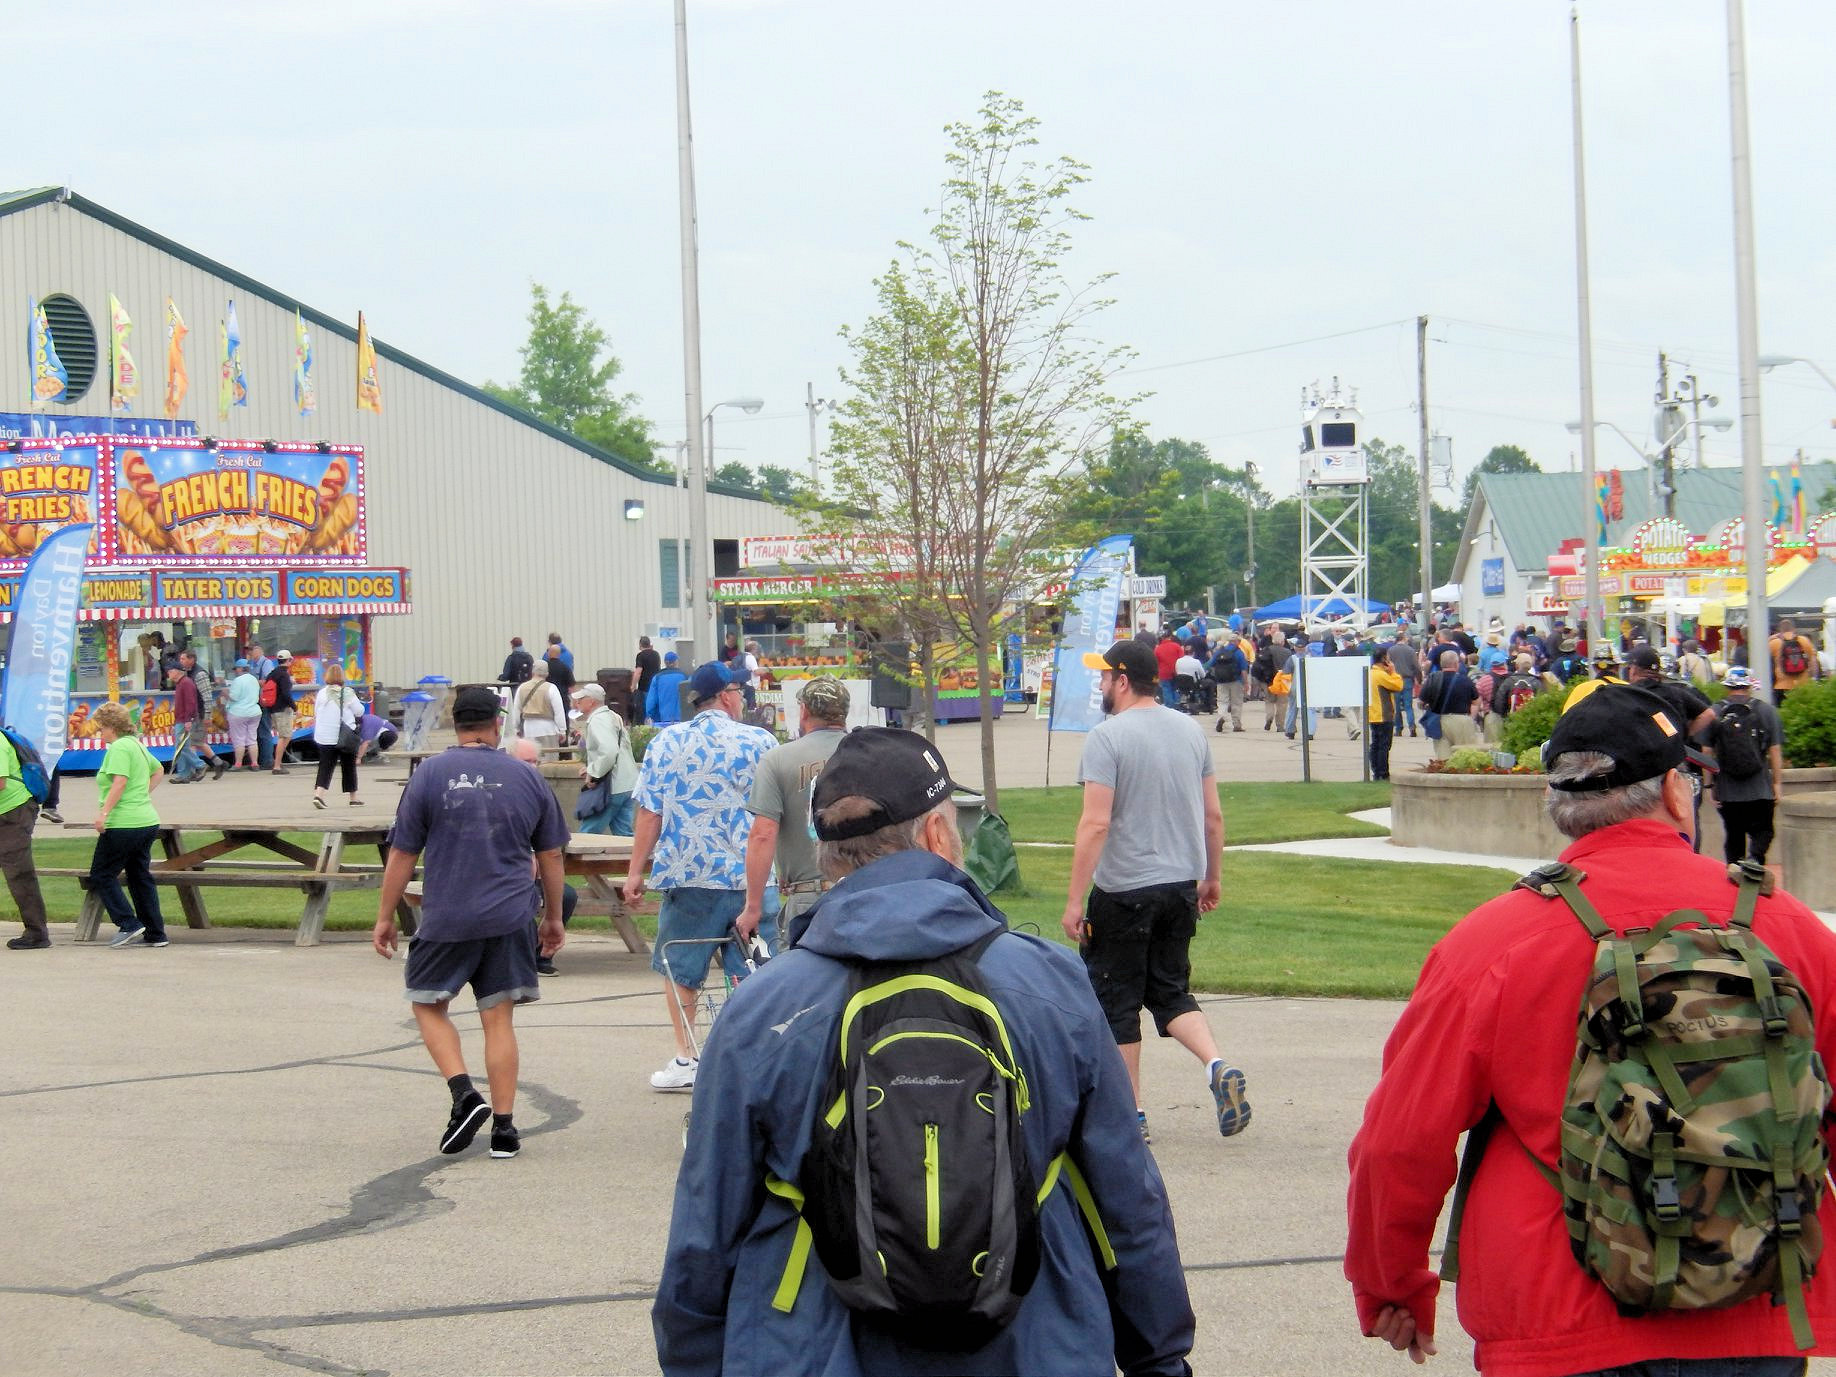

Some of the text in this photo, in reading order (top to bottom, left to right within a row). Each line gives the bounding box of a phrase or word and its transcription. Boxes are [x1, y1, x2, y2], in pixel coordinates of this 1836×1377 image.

[16, 453, 61, 464] Fresh Cut
[217, 454, 263, 468] Fresh Cut
[161, 470, 318, 527] FRENCH FRIES
[8, 496, 71, 522] FRIES
[753, 543, 789, 560] ITALIAN
[1642, 552, 1687, 565] WEDGES
[89, 579, 143, 602] LEMONADE
[163, 578, 273, 599] TATER TOTS
[294, 577, 394, 598] CORN DOGS
[719, 582, 760, 597] STEAK
[762, 580, 813, 597] BURGER
[1132, 580, 1164, 595] COLD DRINKS
[889, 1074, 965, 1087] Eddie Bauer
